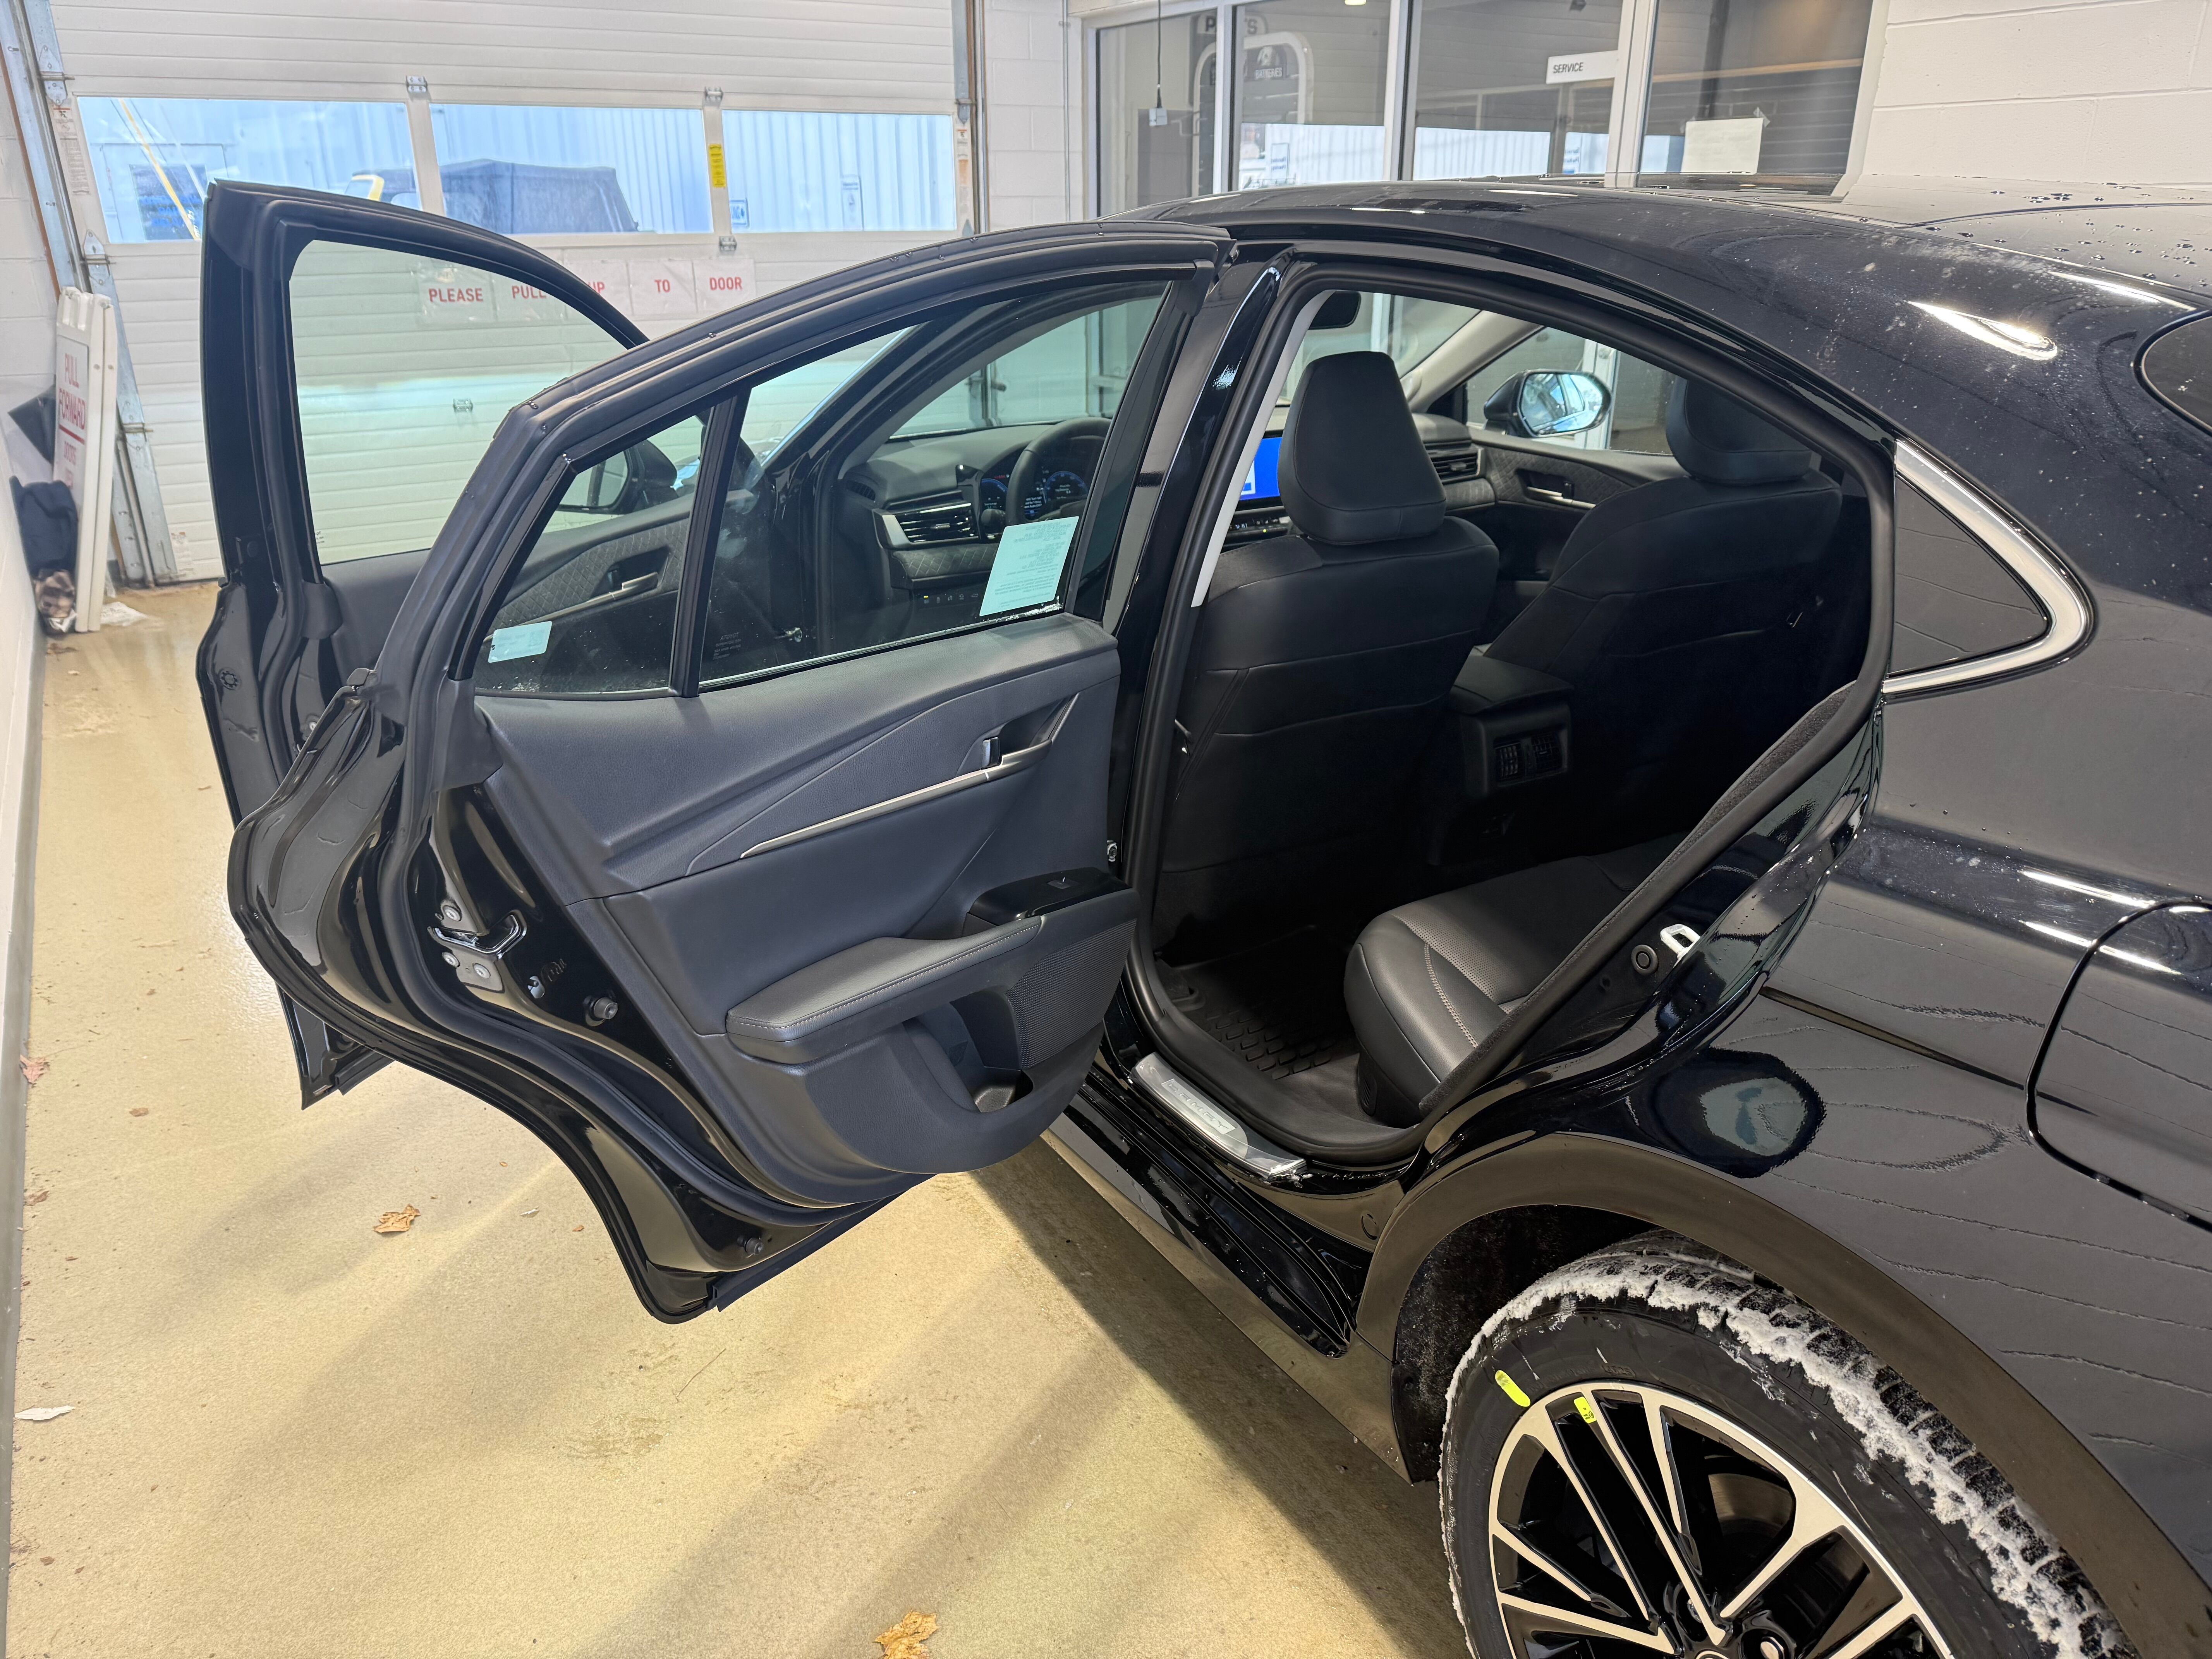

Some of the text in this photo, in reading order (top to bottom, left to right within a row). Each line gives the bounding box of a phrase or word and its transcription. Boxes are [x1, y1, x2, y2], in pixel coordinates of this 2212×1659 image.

[1553, 62, 1584, 74] SERVICE
[428, 288, 483, 302] PLEASE
[512, 285, 546, 299] PULL
[654, 279, 670, 293] TO
[709, 277, 743, 291] DOOR
[65, 353, 79, 388] PULL
[59, 388, 86, 430] FORWARD
[1168, 1083, 1230, 1130] CAMRY
